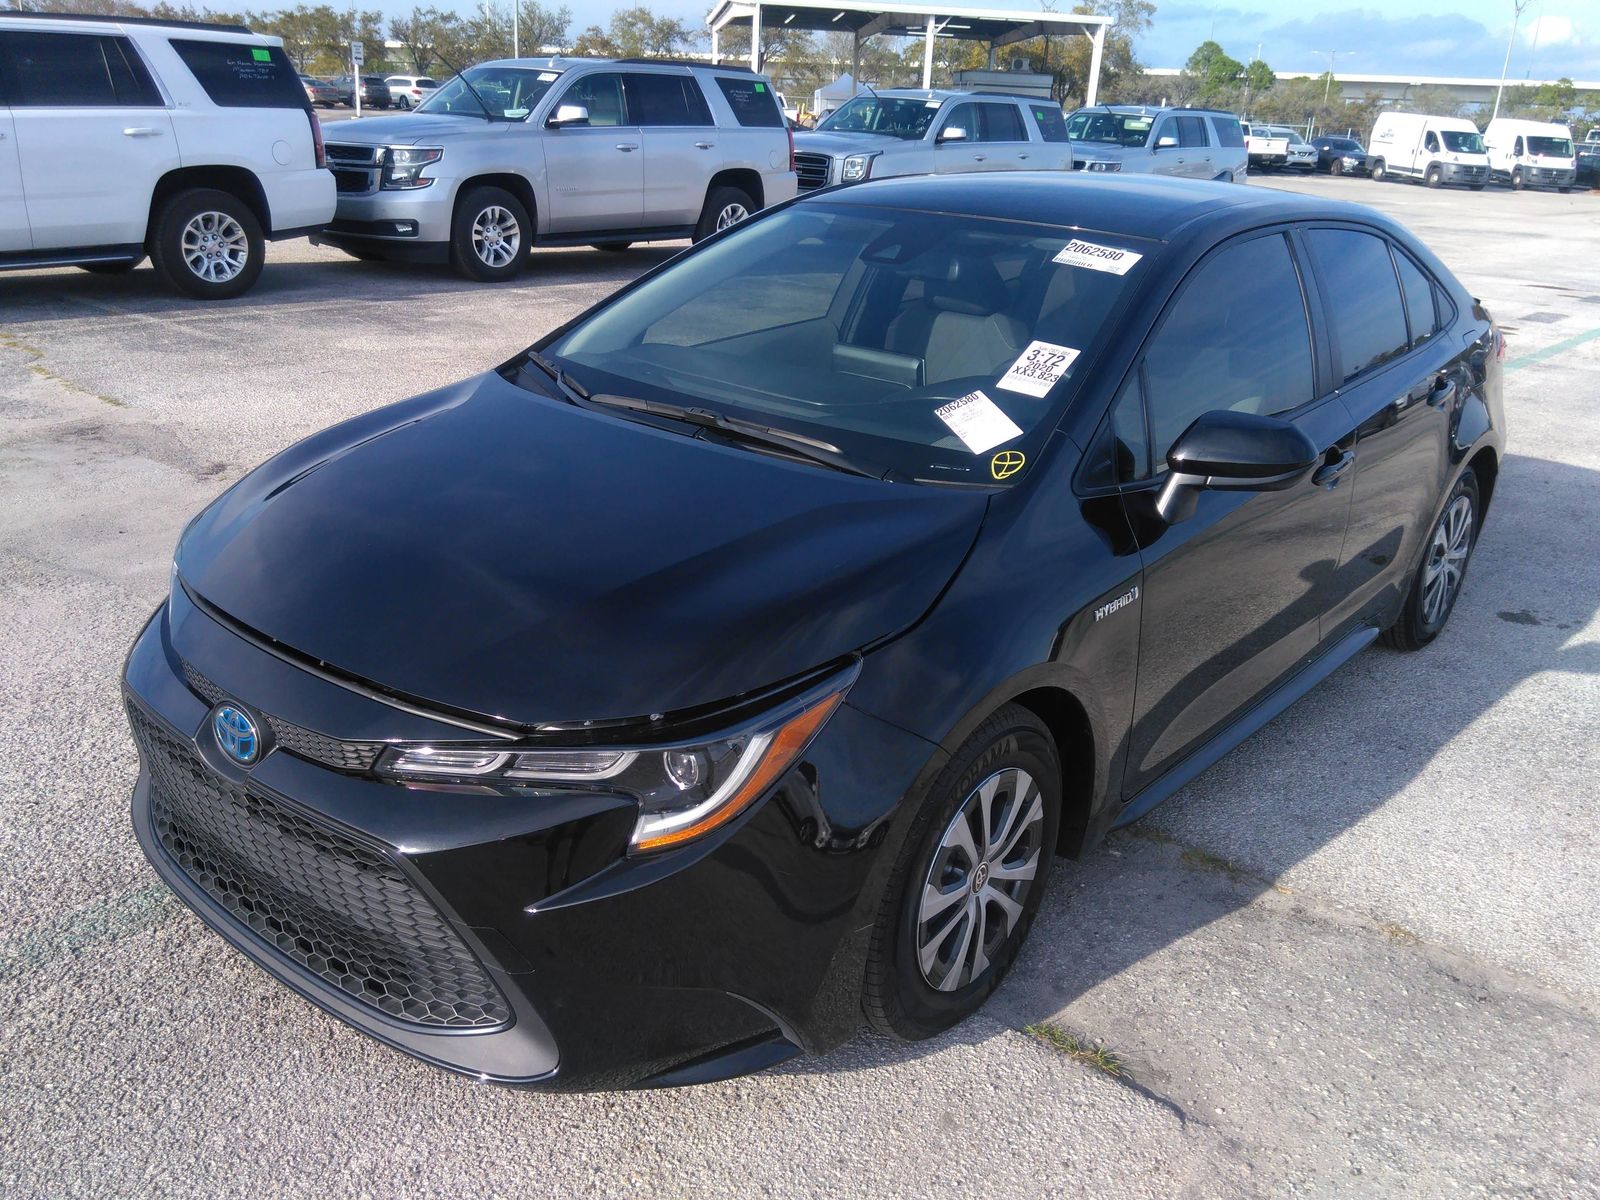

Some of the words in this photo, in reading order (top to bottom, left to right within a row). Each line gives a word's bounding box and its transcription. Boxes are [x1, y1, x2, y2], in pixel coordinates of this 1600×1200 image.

[1065, 242, 1124, 261] 2062580
[1025, 361, 1054, 373] 2020
[1026, 349, 1066, 367] 3:72
[1012, 365, 1060, 383] XX3.823
[936, 393, 980, 416] 2062580
[1094, 592, 1134, 622] HYBRID
